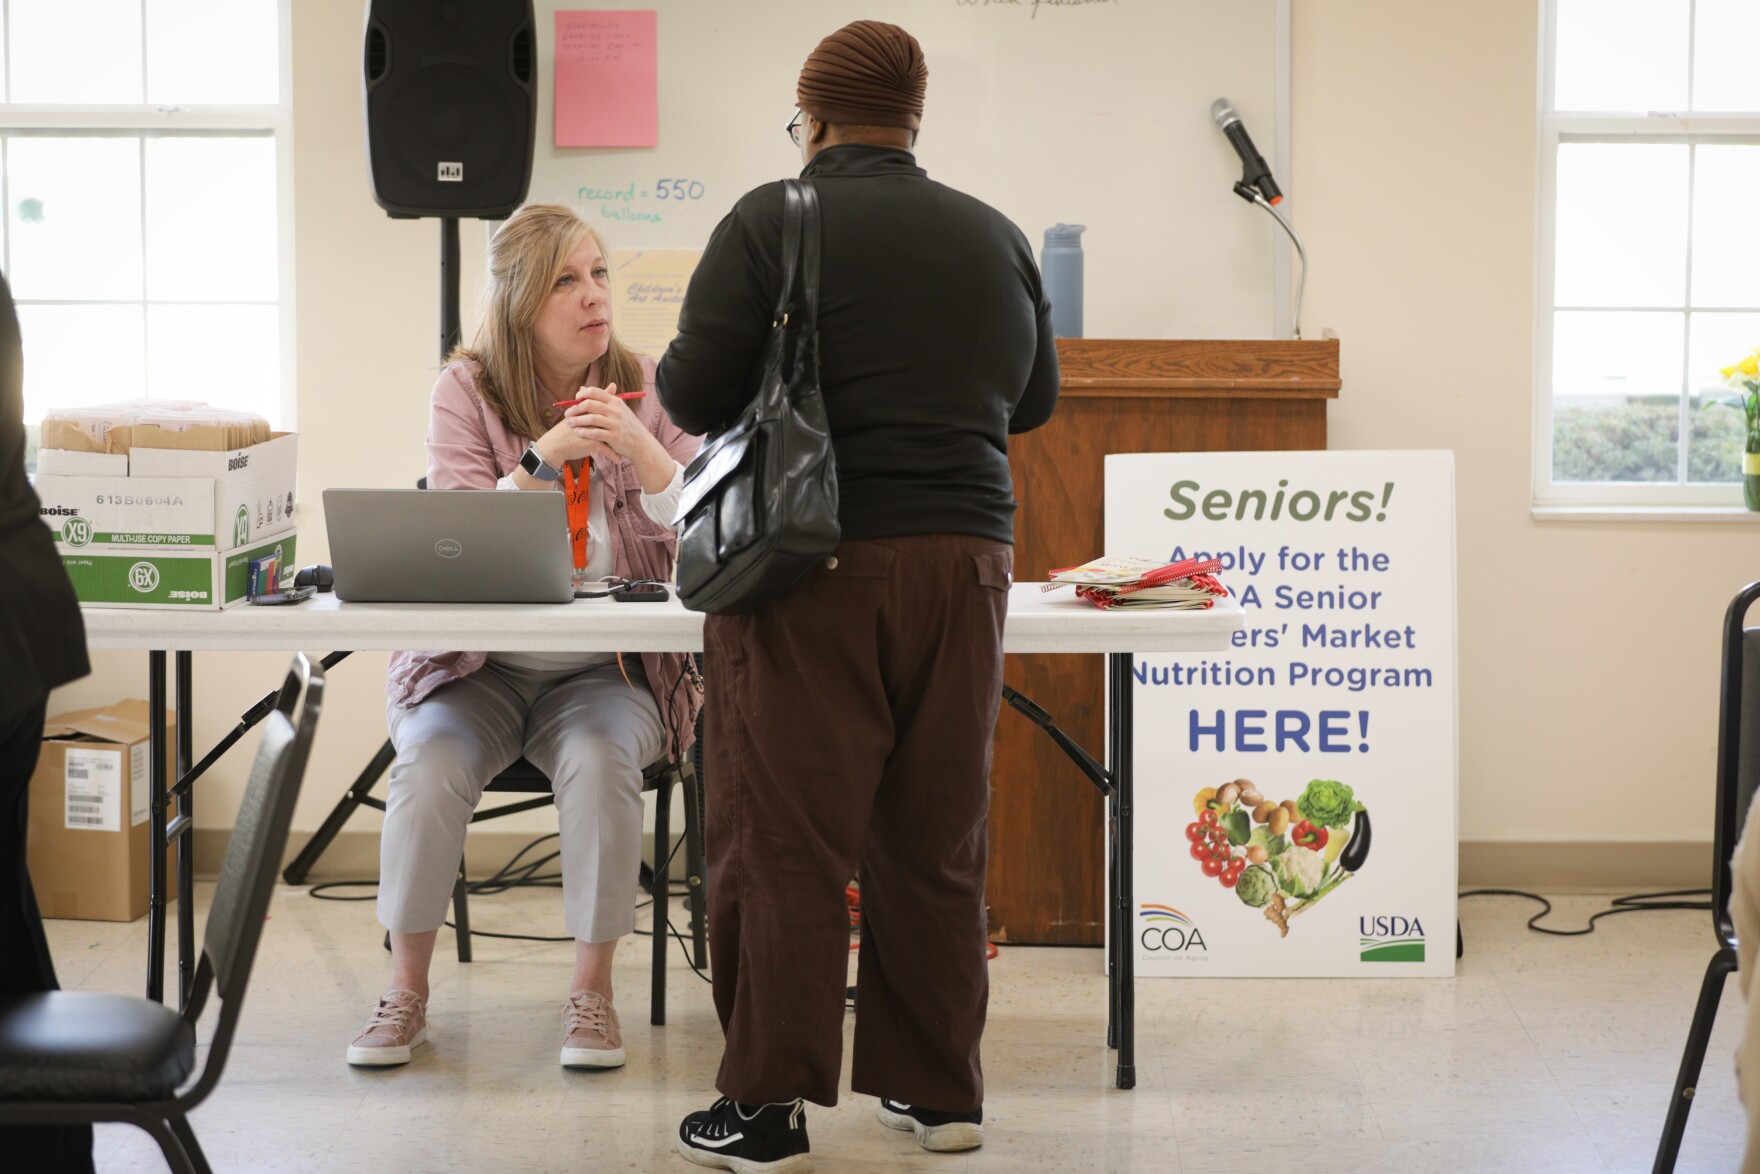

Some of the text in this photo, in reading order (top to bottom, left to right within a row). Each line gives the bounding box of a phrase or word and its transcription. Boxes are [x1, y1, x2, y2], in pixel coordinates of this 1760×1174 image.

[578, 181, 634, 201] record
[656, 178, 705, 200] 550
[601, 204, 663, 222] balloons
[1163, 479, 1395, 522] Seniors!
[111, 534, 191, 544] MULTI-USE COPY PAPER
[1278, 546, 1325, 572] for
[1337, 546, 1390, 572] the
[1274, 585, 1382, 610] Senior
[1302, 623, 1416, 649] Market
[1133, 660, 1433, 692] Nutrition Program
[1188, 709, 1370, 753] HERE!
[1360, 915, 1425, 937] USDA
[1141, 927, 1207, 951] COA
